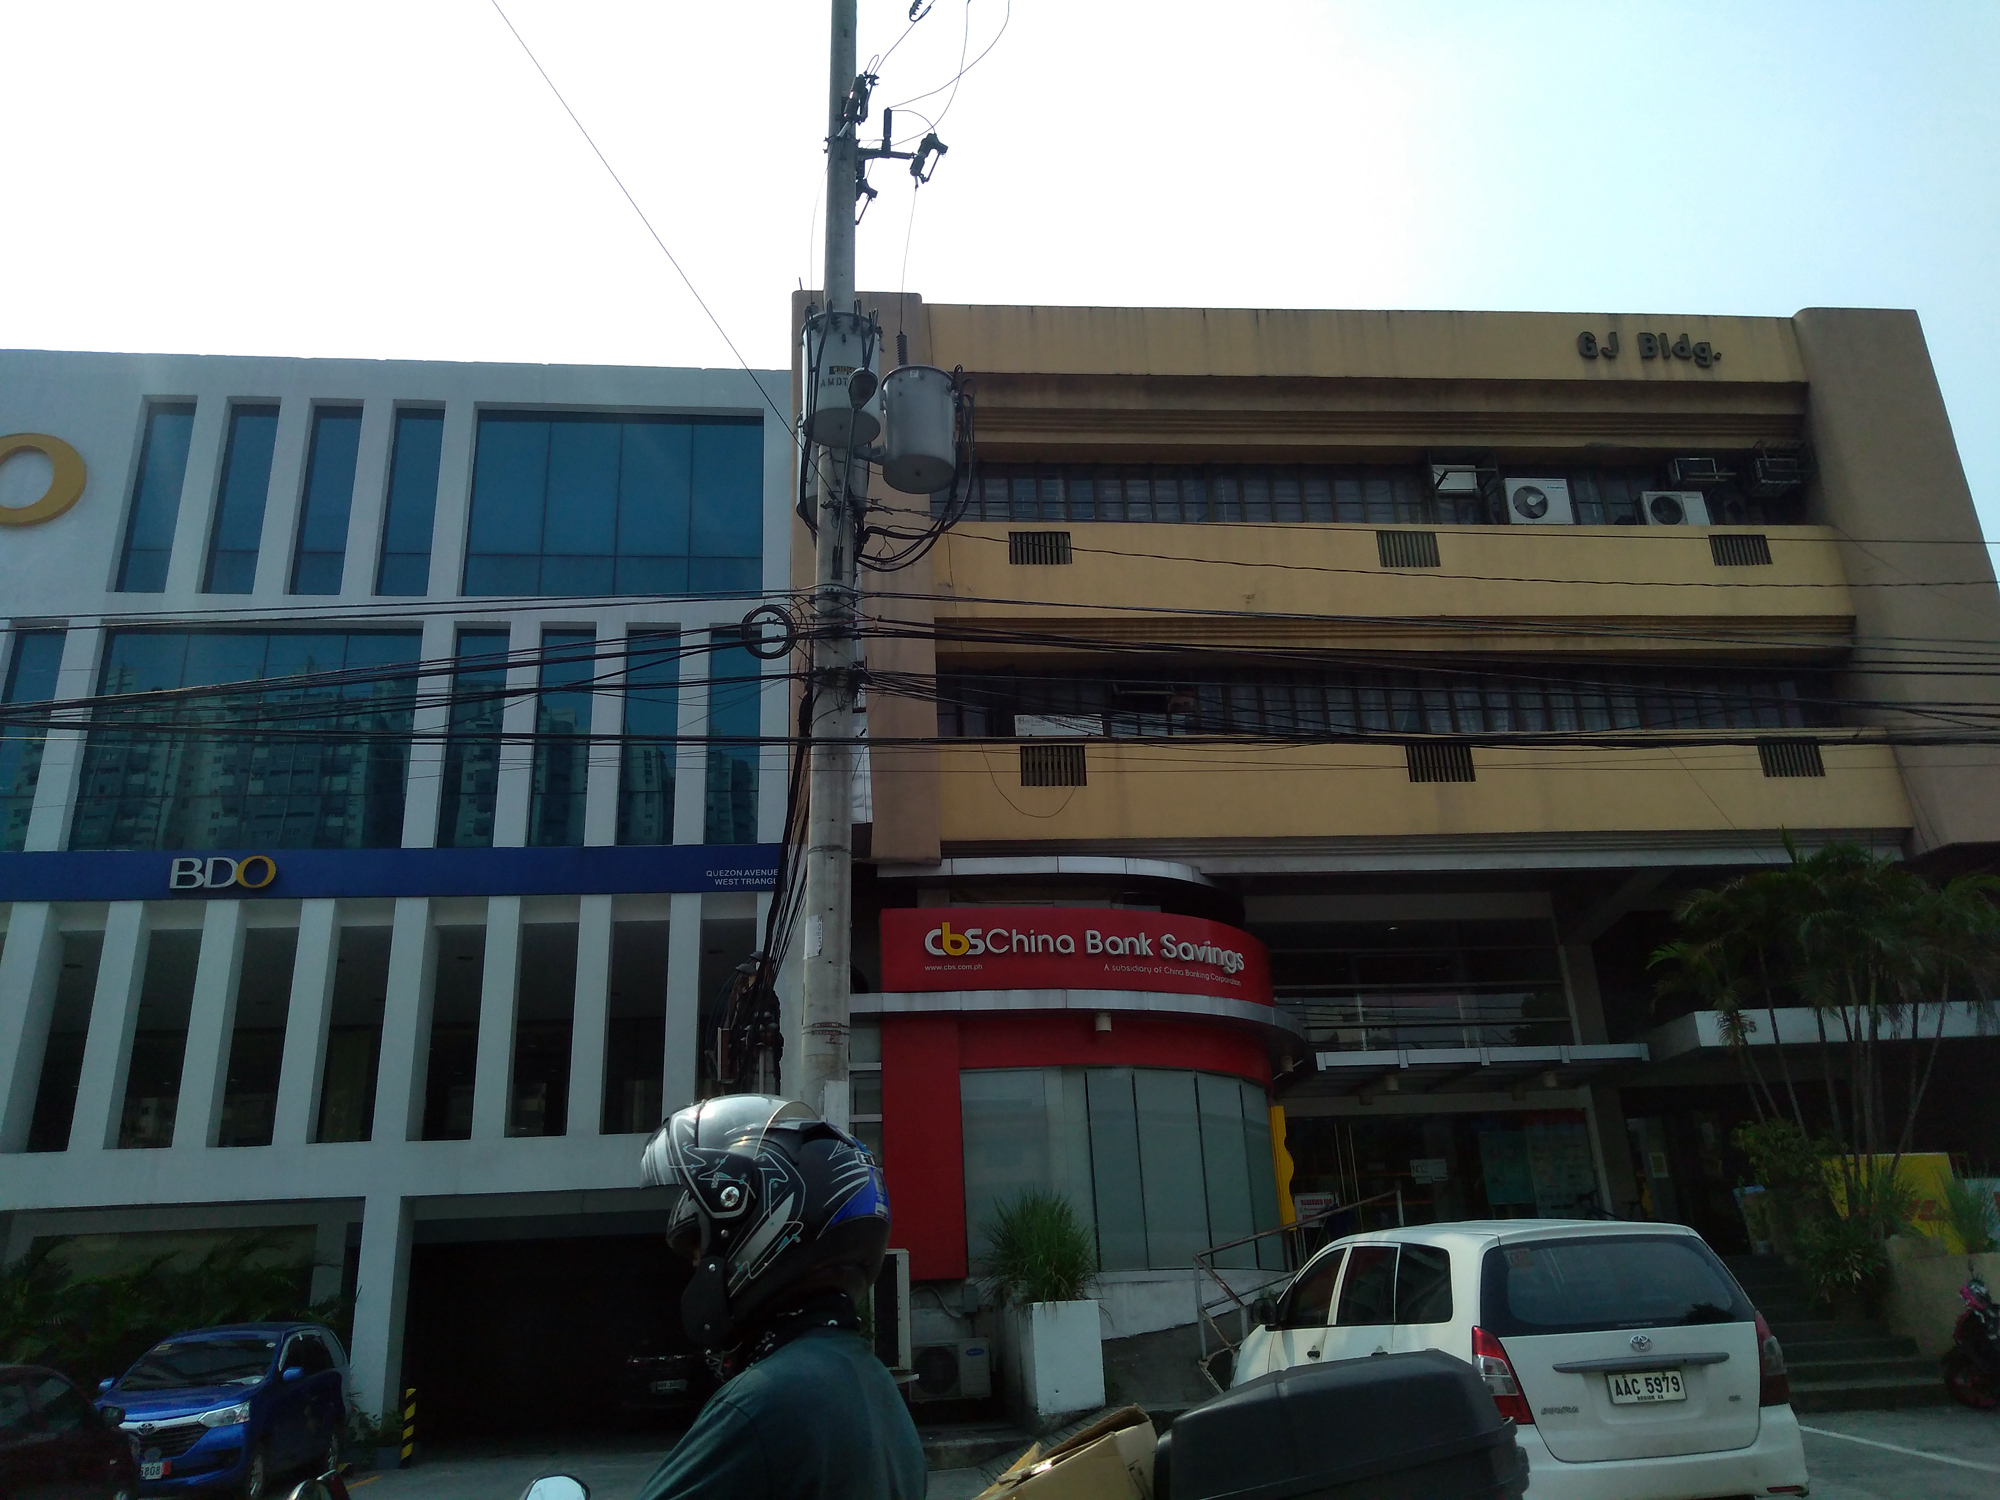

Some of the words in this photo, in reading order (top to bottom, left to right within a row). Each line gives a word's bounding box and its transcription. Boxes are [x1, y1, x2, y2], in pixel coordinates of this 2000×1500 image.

[1577, 331, 1620, 360] GJ
[1636, 332, 1722, 368] Bldg.
[169, 855, 276, 889] BDO
[706, 869, 743, 877] QUEZON
[743, 868, 779, 876] AVENUE
[714, 878, 739, 886] WEST
[924, 922, 986, 957] cbs
[985, 928, 1075, 954] China
[1085, 929, 1154, 956] Bank
[1160, 933, 1245, 974] Savings
[924, 963, 983, 971] www.cbs.com.ph
[1112, 964, 1151, 975] subsidiary
[1153, 965, 1162, 974] of
[1164, 966, 1184, 976] China
[1185, 969, 1210, 981] Banking
[1210, 973, 1242, 987] Corporation
[1615, 1378, 1641, 1397] AAC
[1644, 1376, 1681, 1395] 5979
